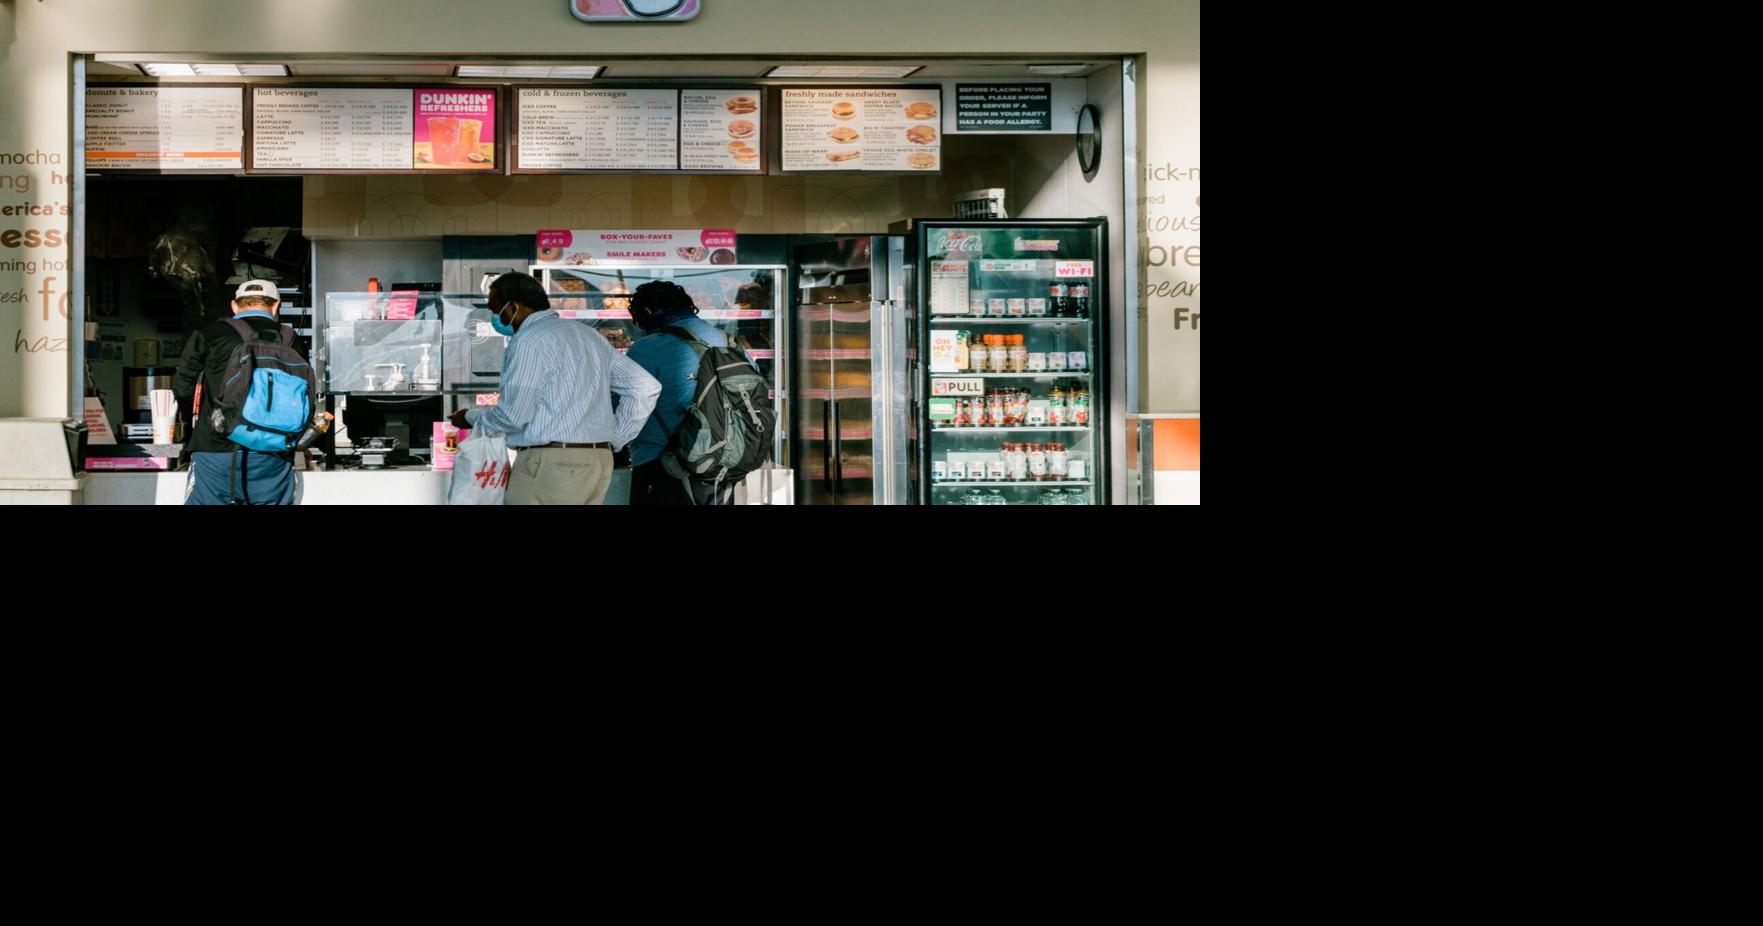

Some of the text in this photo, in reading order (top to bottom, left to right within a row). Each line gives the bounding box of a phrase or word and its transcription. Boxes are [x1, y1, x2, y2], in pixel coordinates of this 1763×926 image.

[129, 89, 159, 97] bakery
[274, 89, 318, 97] beverages
[584, 90, 627, 98] beverages
[785, 91, 815, 99] freshly
[420, 94, 492, 104] DUNKIN'
[0, 202, 72, 216] erica's
[948, 383, 980, 392] PULL
